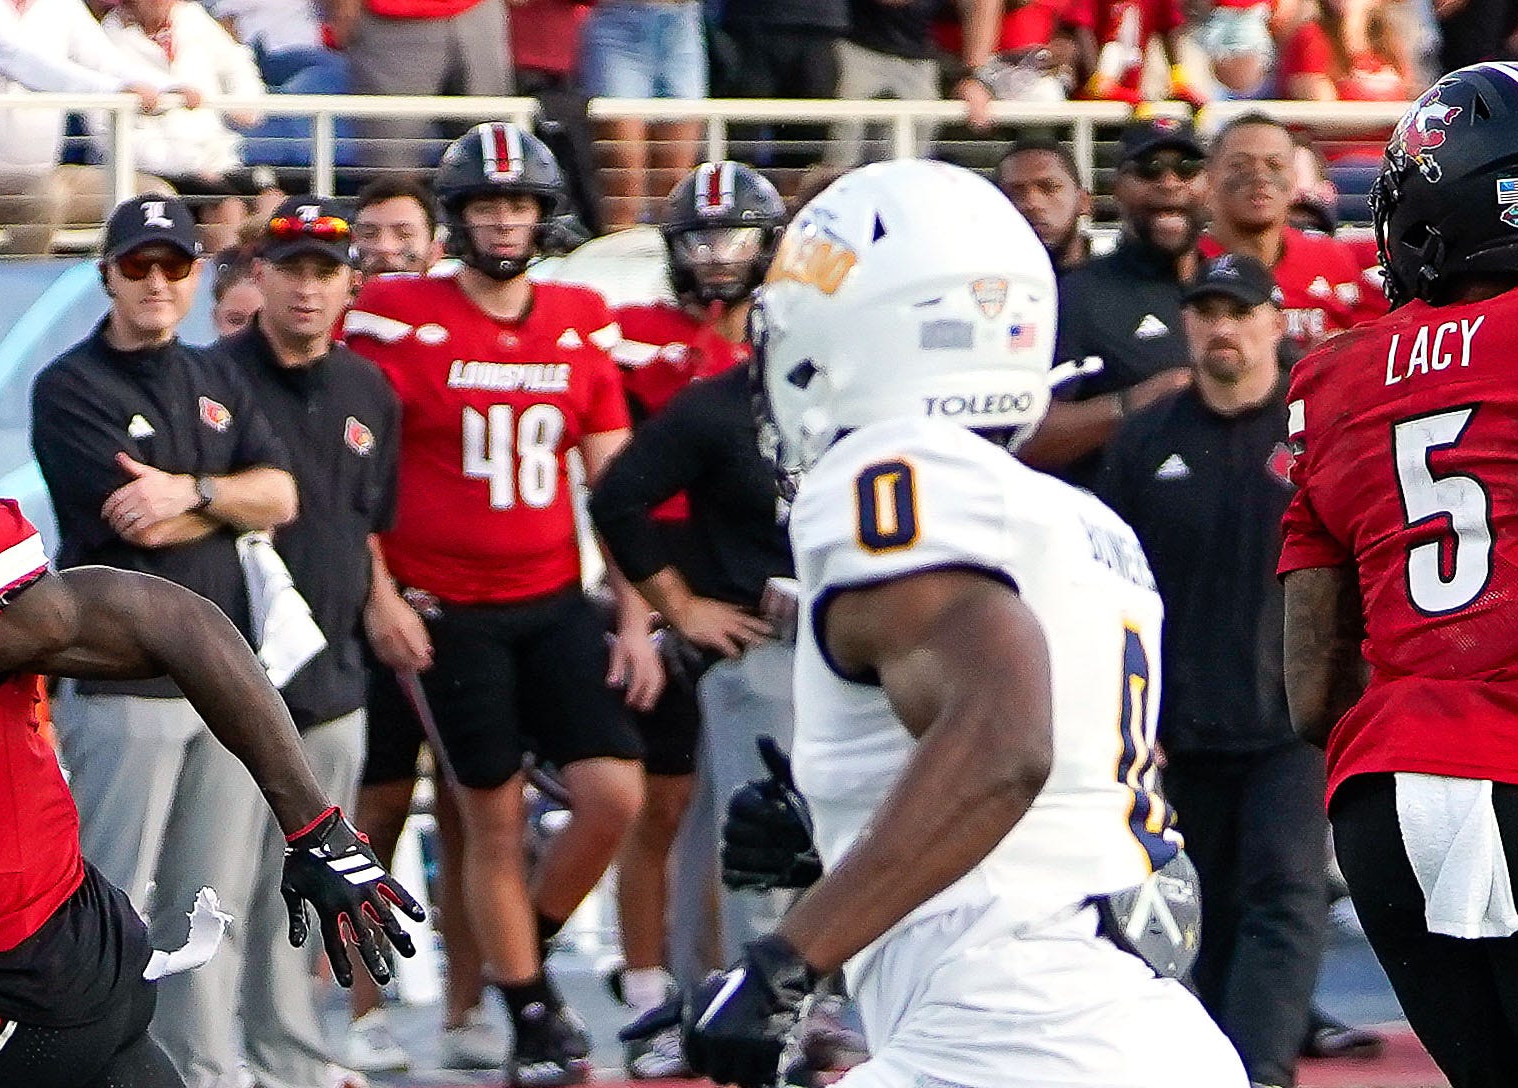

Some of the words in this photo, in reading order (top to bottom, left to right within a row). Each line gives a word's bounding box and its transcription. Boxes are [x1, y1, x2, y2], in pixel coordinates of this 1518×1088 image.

[140, 201, 176, 229] L
[1384, 314, 1485, 386] LACY
[922, 392, 1033, 417] TOLEDO
[462, 403, 565, 510] 48
[854, 460, 919, 552] 0
[1393, 402, 1492, 614] 5
